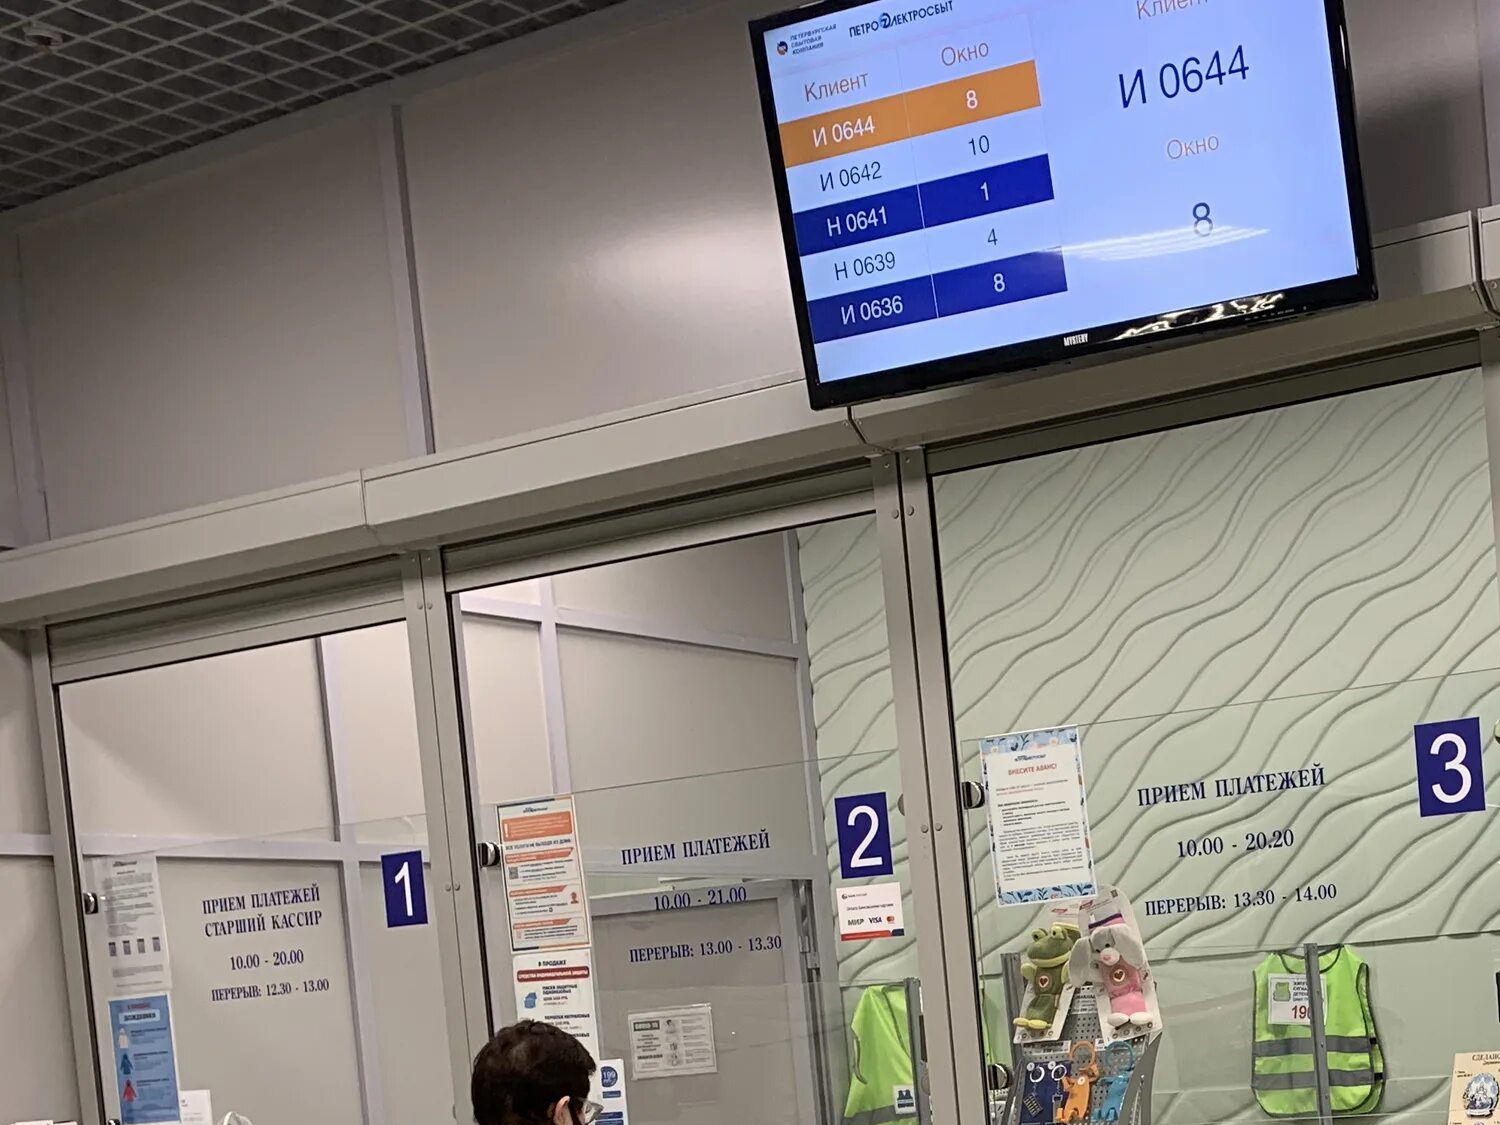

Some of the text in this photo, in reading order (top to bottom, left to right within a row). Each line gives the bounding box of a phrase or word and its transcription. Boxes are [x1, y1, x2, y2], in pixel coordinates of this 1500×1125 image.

[1137, 0, 1208, 19] Клие
[804, 43, 989, 102] Клиент Окно
[1118, 45, 1250, 109] И 0644
[812, 90, 979, 147] И 0644 8
[819, 134, 991, 193] И 0642 10
[1166, 133, 1221, 161] Окно
[827, 181, 990, 237] Н 0641 1
[1192, 202, 1213, 238] 8
[834, 227, 998, 282] Н 0639 4
[841, 272, 1006, 325] И 0636 8
[1063, 333, 1088, 347] MYSTERY
[1008, 765, 1035, 776] ВНЕСИТЕ
[1137, 763, 1325, 806] ПРИЕМ ПЛАТЕЖЕЙ
[1428, 731, 1474, 805] 3
[621, 828, 770, 865] ПРИЕМ ПЛАТЕЖЕЙ
[847, 805, 883, 868] 2
[1178, 828, 1294, 858] 10.00 20.20
[202, 883, 320, 915] ПРИЕМ ПЛАТЕЖЕЙ
[393, 860, 414, 917] 1
[654, 886, 747, 911] 10.00 21.00
[1145, 883, 1337, 916] ПЕРЕРЫВ: 13.30 14.00
[205, 910, 322, 937] СТАРШИЙ КАССИР
[847, 916, 882, 926] МИР VISA
[230, 949, 304, 971] 10.00 20.00
[630, 935, 782, 962] ПЕРЕРЫВ: 13.00 13.30
[211, 978, 330, 1001] ПЕРЕРЫВ: 12.30 13.00
